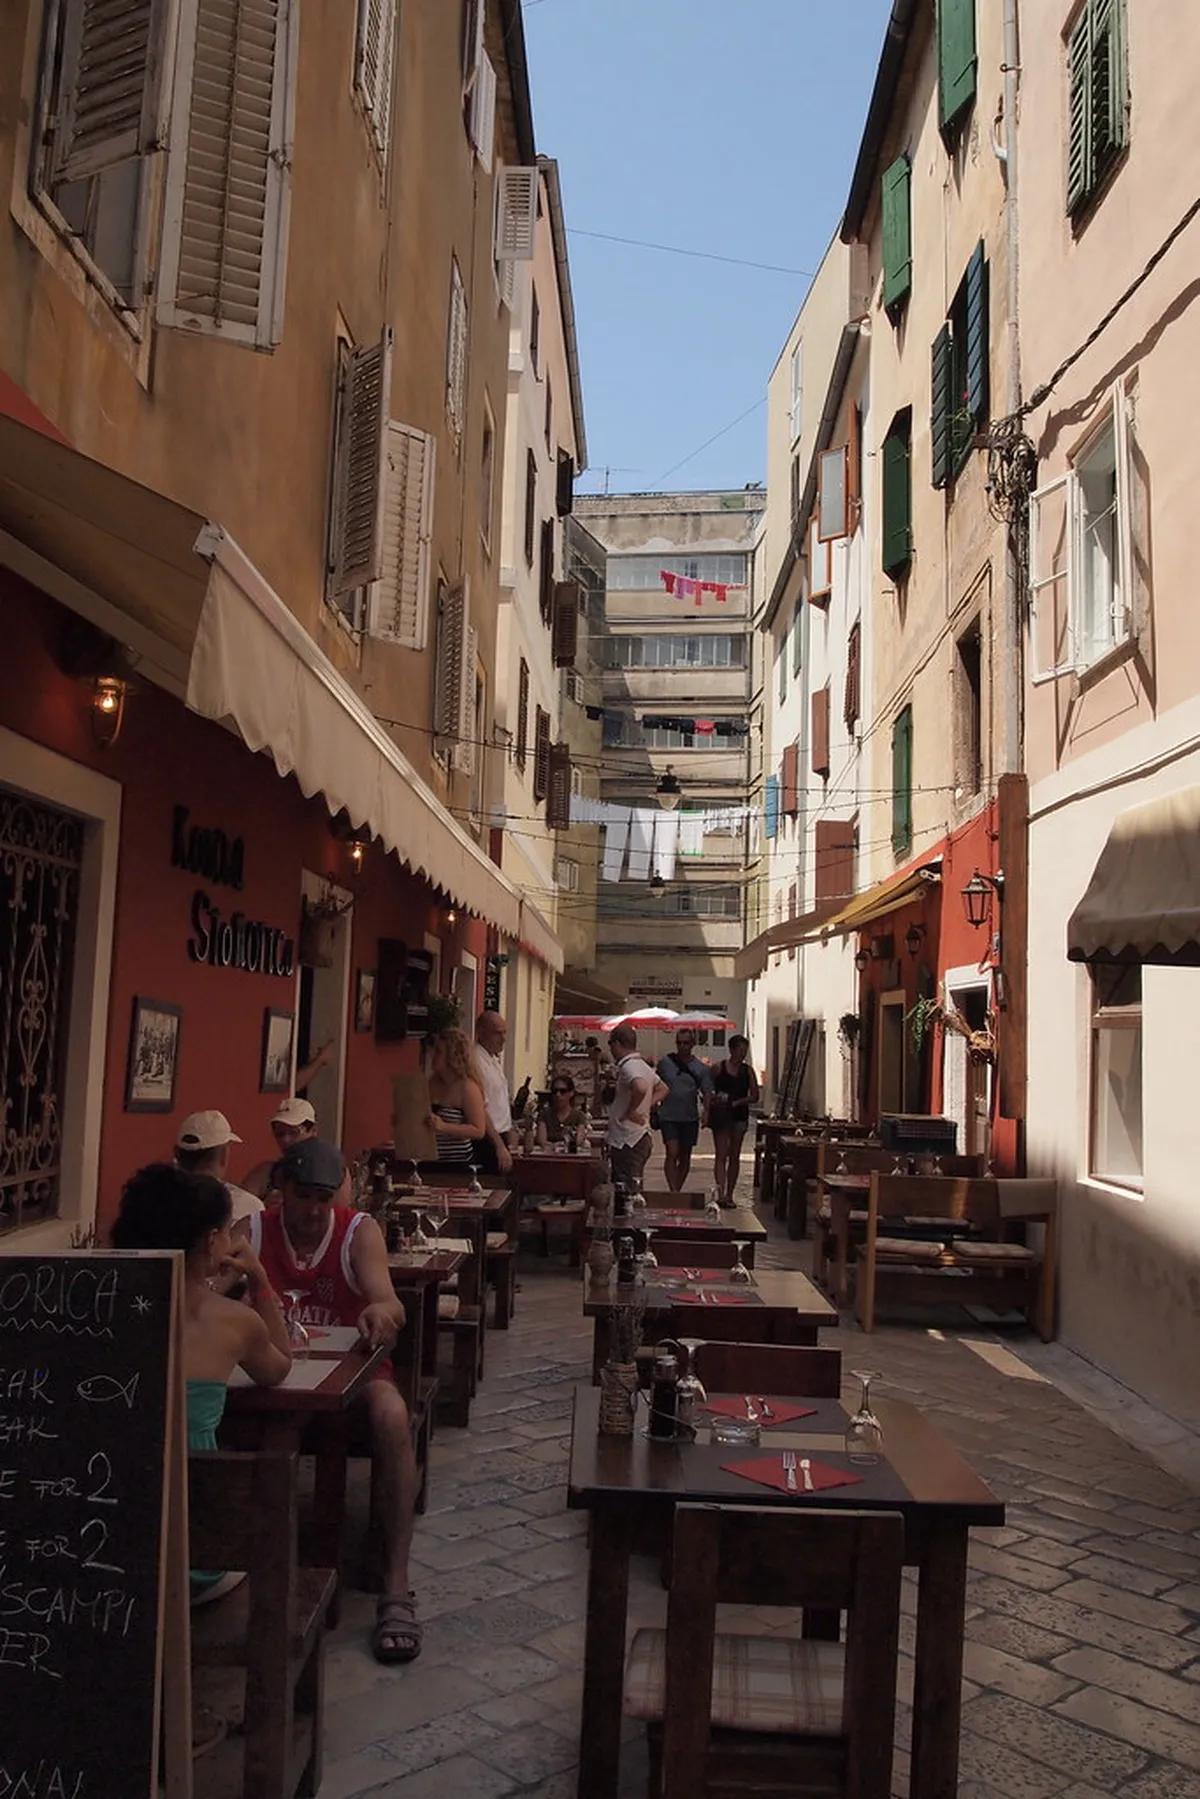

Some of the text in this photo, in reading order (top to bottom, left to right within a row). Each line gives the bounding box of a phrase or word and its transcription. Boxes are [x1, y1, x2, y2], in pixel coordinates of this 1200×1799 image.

[30, 1477, 82, 1501] FOR
[87, 1451, 118, 1504] 2
[25, 1535, 78, 1561] FOR
[80, 1518, 125, 1574] 2
[0, 1582, 135, 1637] SCAMPI
